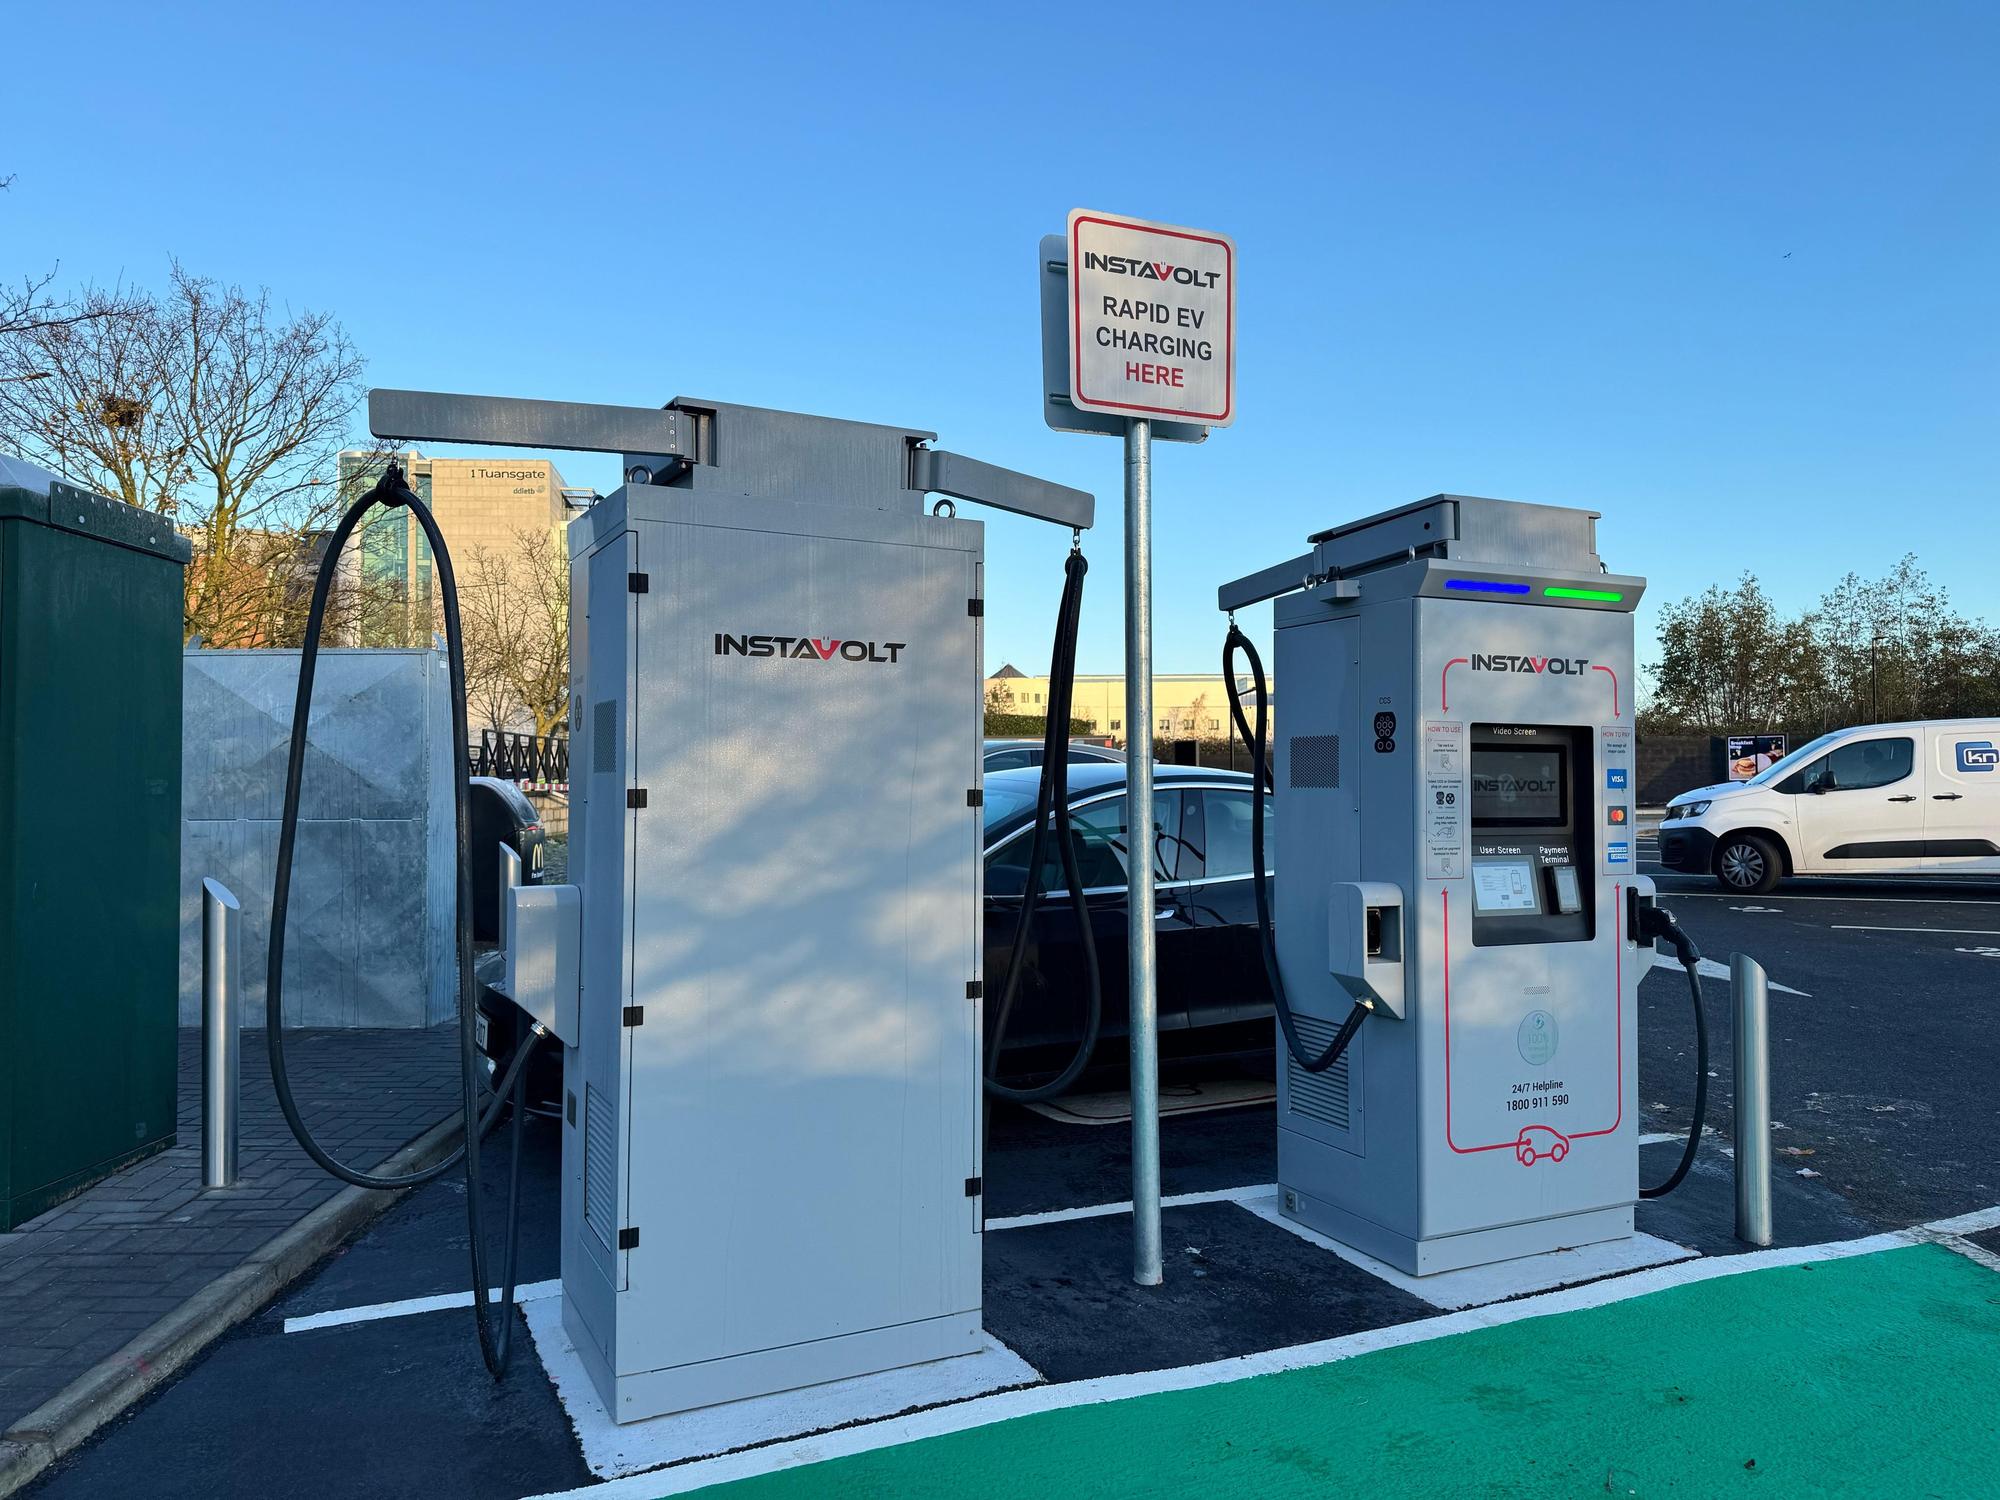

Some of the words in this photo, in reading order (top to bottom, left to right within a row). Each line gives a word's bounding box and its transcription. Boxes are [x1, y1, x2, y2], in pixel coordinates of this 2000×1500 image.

[1084, 251, 1221, 289] INSTAVOLT
[1103, 295, 1170, 324] RAPID
[1177, 307, 1205, 329] EV
[1096, 326, 1212, 361] CHARGING
[1126, 361, 1184, 388] HERE
[471, 469, 475, 478] 1
[714, 633, 907, 663] INSTAVOLT
[1471, 653, 1589, 676] INSTAVOLT
[1492, 726, 1512, 735] Video
[1513, 727, 1537, 736] Screen
[1611, 775, 1625, 783] VISA
[1474, 780, 1556, 792] INSTAVOLT
[1480, 846, 1496, 854] User
[1497, 846, 1521, 854] Screen
[1539, 846, 1568, 856] Payment
[1541, 855, 1570, 864] Terminal
[1512, 1083, 1531, 1093] 24/7
[1532, 1080, 1564, 1093] Helpline
[1506, 1099, 1530, 1111] 1800
[1532, 1096, 1548, 1109] 911
[1552, 1093, 1569, 1106] 590
